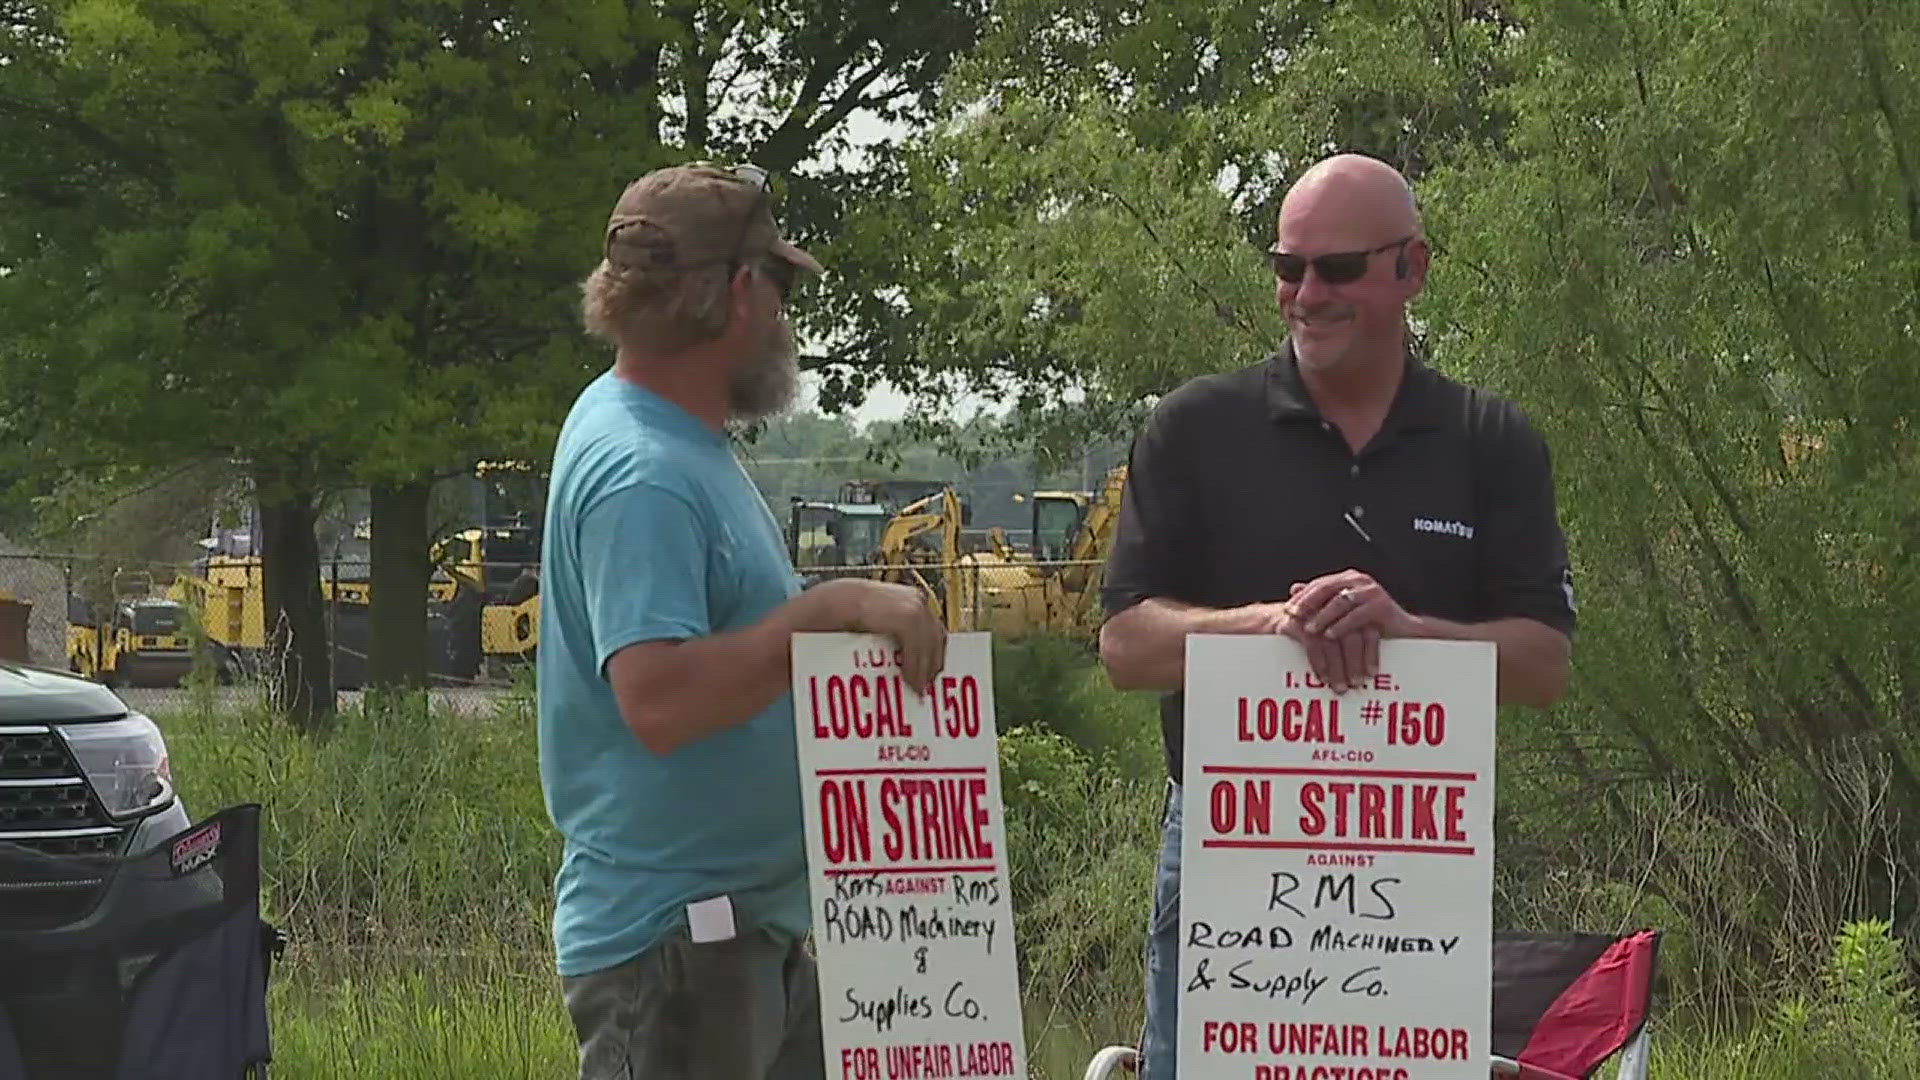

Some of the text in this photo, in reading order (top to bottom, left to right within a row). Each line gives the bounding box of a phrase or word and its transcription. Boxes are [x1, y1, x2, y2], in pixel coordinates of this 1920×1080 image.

[1414, 518, 1474, 539] KOMATSU
[1285, 671, 1400, 691] I.U..E.
[809, 674, 912, 739] LOCAL
[1238, 697, 1446, 747] LOCAL #150
[877, 745, 931, 761] AFL-CIO
[1311, 749, 1375, 763] AFL-CIO
[820, 777, 994, 864] ON STRIKE
[1210, 780, 1467, 841] ON STRIKE
[1306, 854, 1376, 867] AGAINST
[885, 877, 946, 895] AGAINST
[1268, 872, 1401, 920] RMS
[824, 897, 995, 955] ROAD Machinery
[1187, 922, 1293, 949] ROAD
[1187, 958, 1389, 1005] & Supply Co.
[840, 981, 988, 1033] Supplies Co.
[841, 1041, 1015, 1080] FOR UNFAIR LABOR
[1203, 1022, 1469, 1061] FOR UNFAIR LABOR
